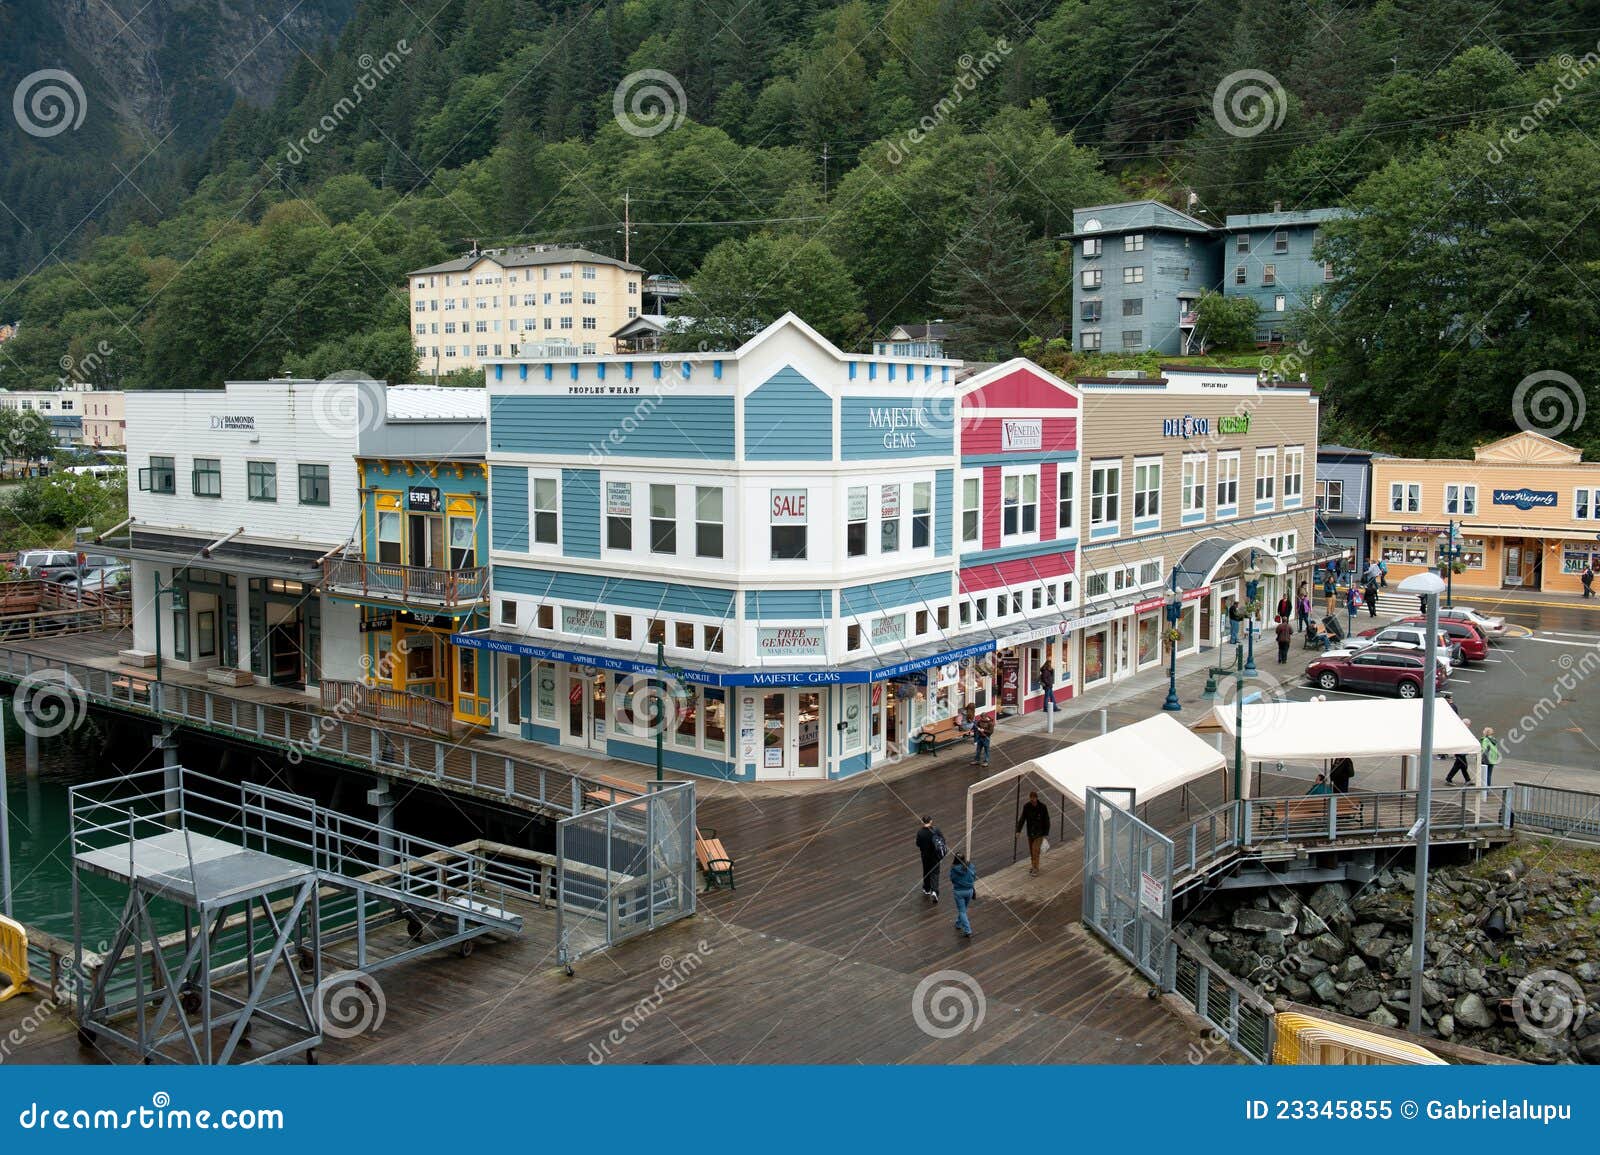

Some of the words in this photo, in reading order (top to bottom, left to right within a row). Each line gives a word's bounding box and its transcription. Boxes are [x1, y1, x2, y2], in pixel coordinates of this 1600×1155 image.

[609, 386, 640, 394] WHARF
[224, 415, 255, 423] DIAMONDS
[868, 407, 928, 433] MAJESTIC
[1193, 417, 1210, 435] SOL
[883, 432, 916, 449] GEMS
[773, 495, 806, 517] SALE
[1564, 559, 1589, 570] SALE
[777, 628, 807, 638] FREE
[761, 637, 820, 648] GEMSTONE
[753, 673, 804, 685] MAJESTIC
[808, 672, 841, 683] GEMS
